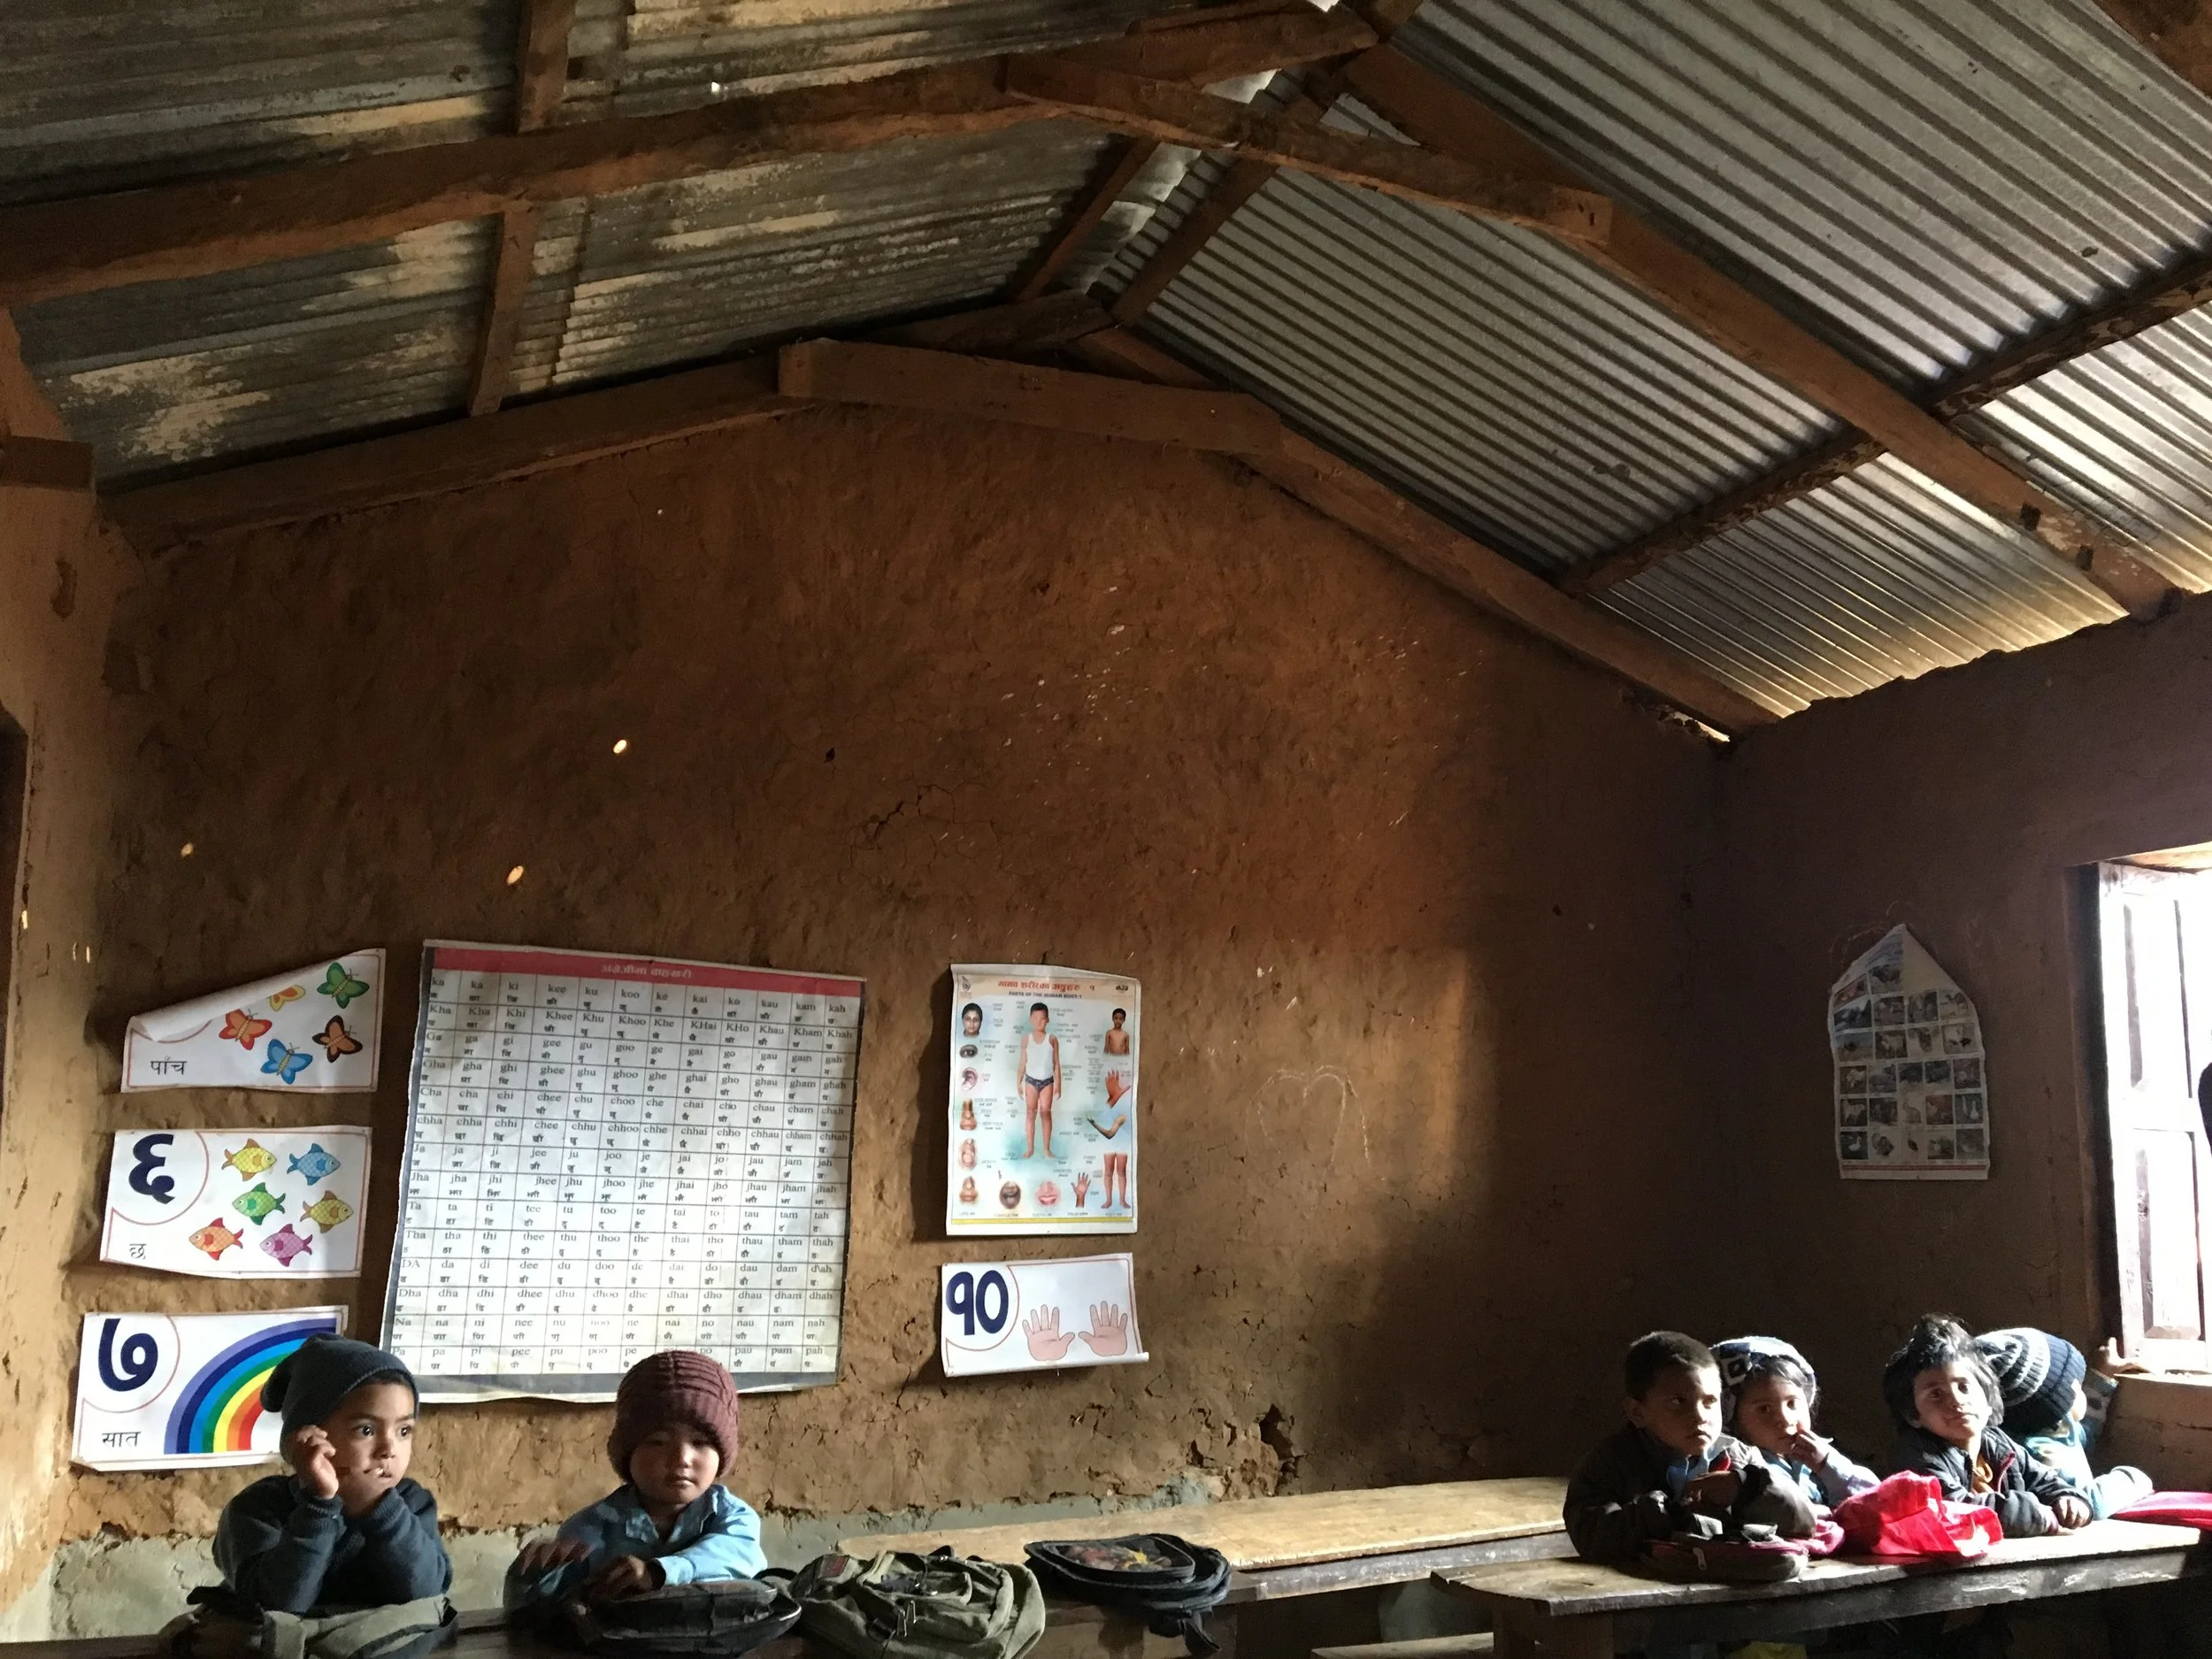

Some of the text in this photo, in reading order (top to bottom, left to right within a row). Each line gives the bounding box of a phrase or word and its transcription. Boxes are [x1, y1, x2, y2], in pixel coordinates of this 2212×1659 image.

[150, 1055, 188, 1075] पाँच
[128, 1133, 175, 1204] ६
[98, 1317, 158, 1392] ७
[102, 1431, 142, 1448] सात
